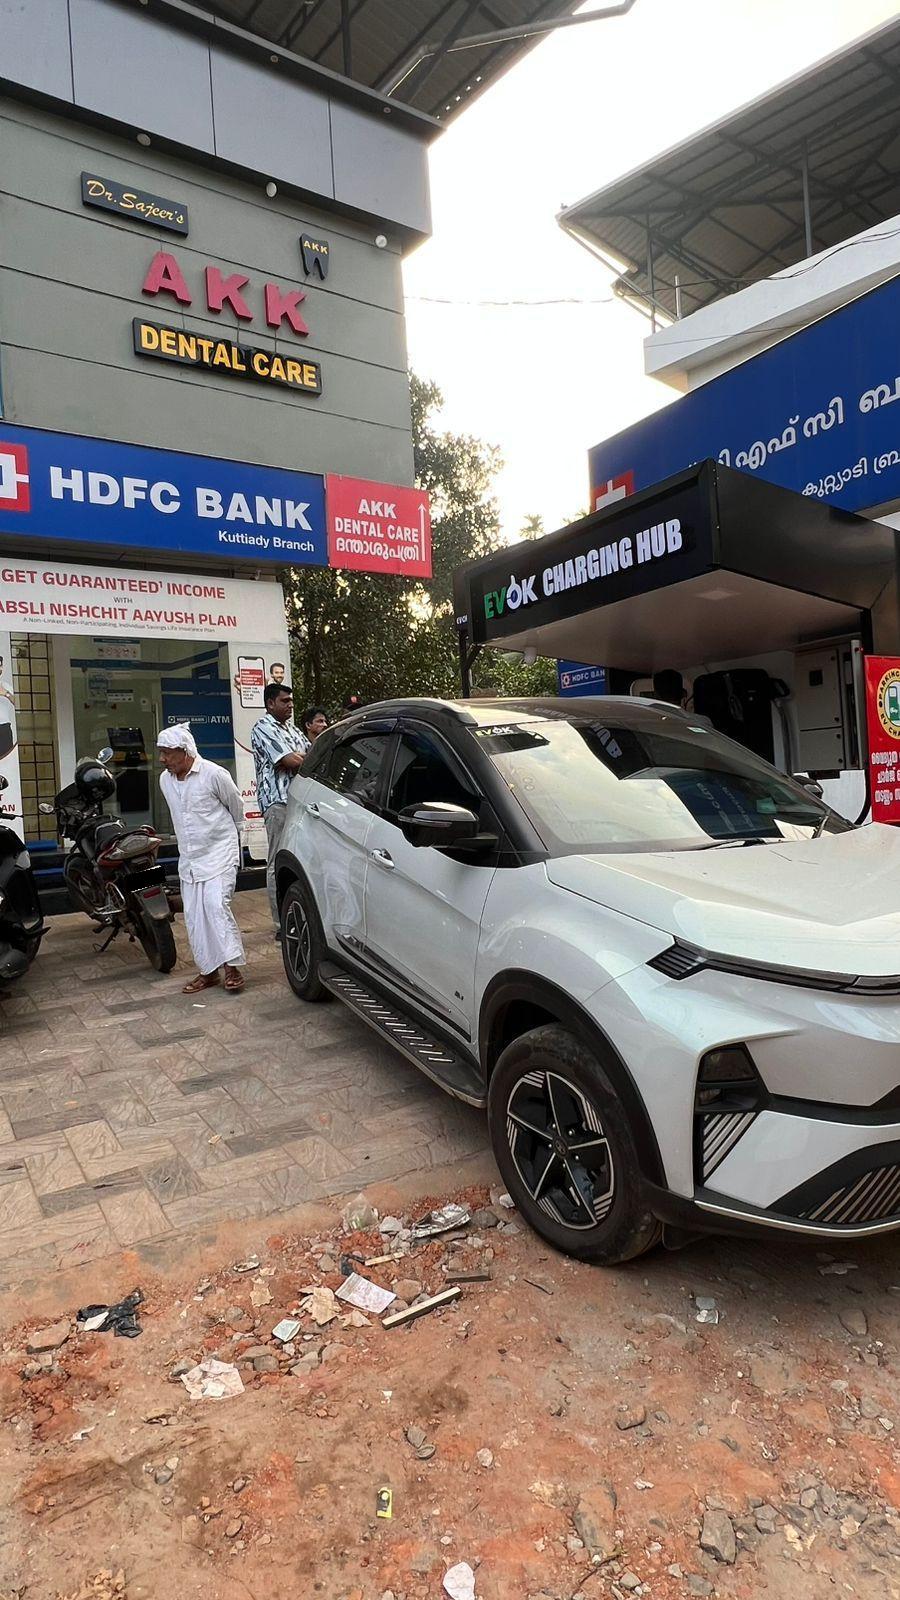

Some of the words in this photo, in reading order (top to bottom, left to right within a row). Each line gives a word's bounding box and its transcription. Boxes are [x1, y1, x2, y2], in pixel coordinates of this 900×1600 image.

[303, 240, 328, 254] AKK
[142, 251, 309, 337] AKK
[140, 324, 246, 372] DENTAL
[253, 353, 318, 388] CARE
[50, 465, 181, 513] HDFC
[195, 487, 313, 531] BANK
[358, 498, 397, 519] AKK
[218, 530, 270, 549] Kuttiady
[272, 536, 314, 552] Branch
[335, 516, 384, 538] DENTAL
[387, 524, 419, 543] CARE
[483, 575, 538, 620] EVOK
[542, 536, 633, 597] CHARGING
[635, 518, 683, 565] HUB
[1, 568, 37, 584] GET
[167, 582, 226, 599] INCOME
[113, 596, 133, 604] WITH
[49, 603, 128, 620] NISHCHIT
[132, 609, 195, 625] AAYUSH
[198, 613, 237, 628] PLAN
[572, 672, 590, 682] HDFC
[210, 715, 230, 724] ATM
